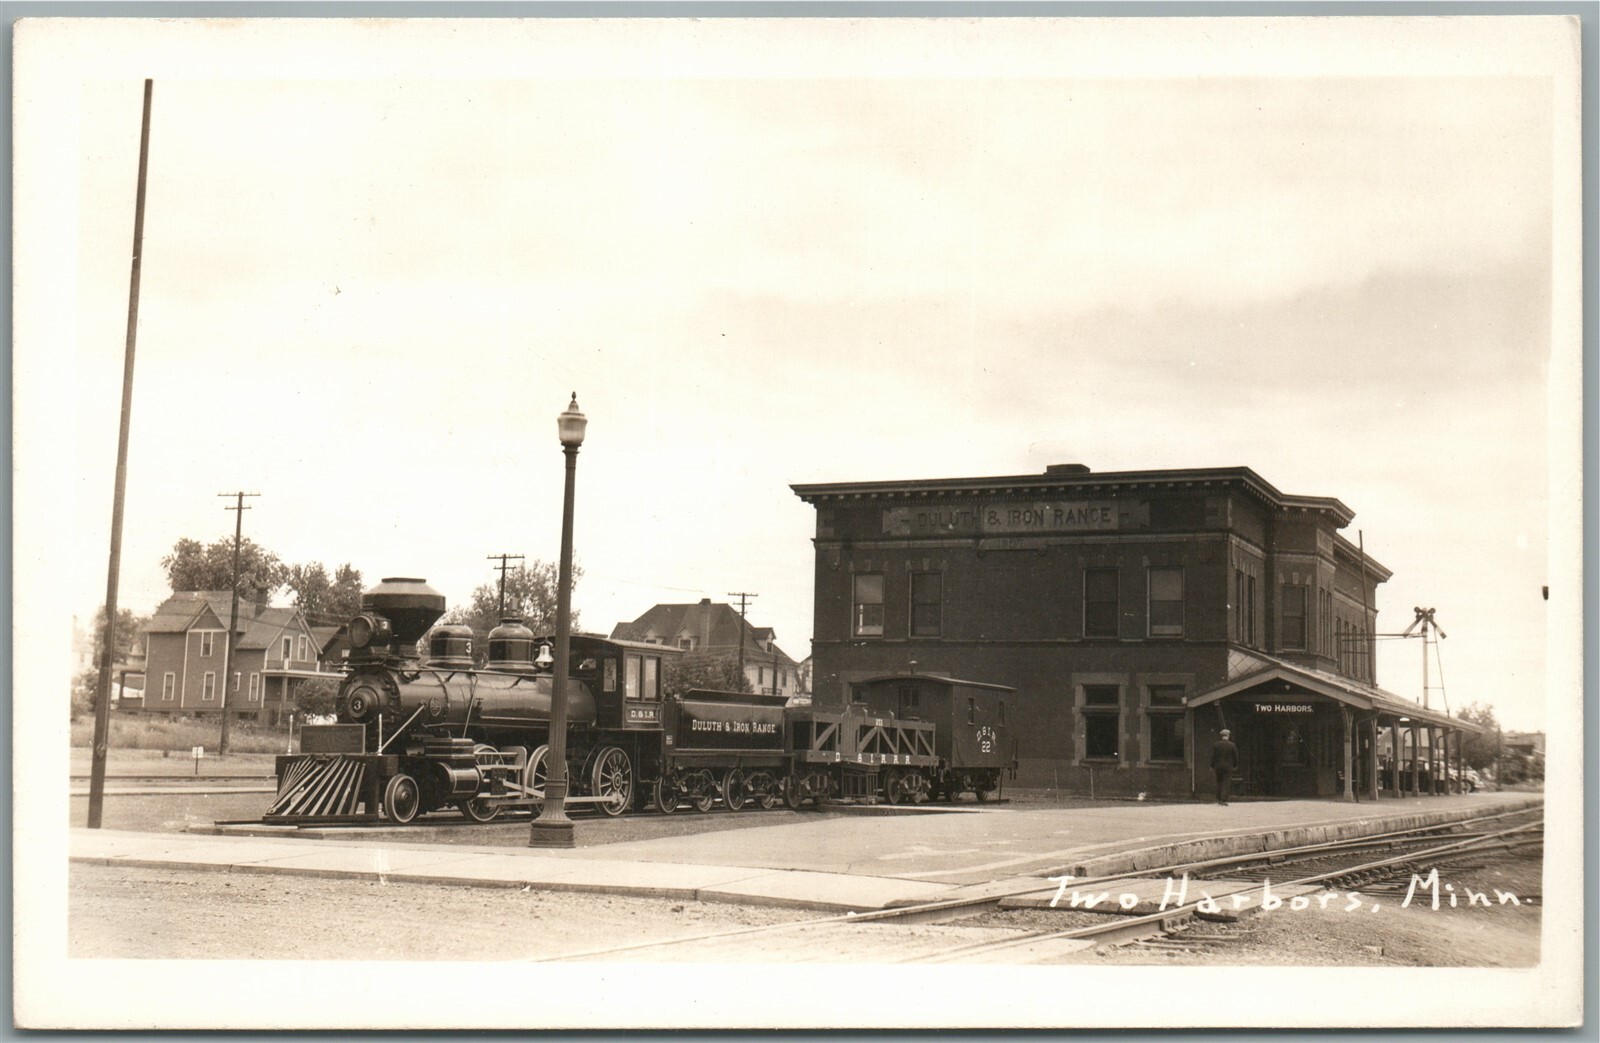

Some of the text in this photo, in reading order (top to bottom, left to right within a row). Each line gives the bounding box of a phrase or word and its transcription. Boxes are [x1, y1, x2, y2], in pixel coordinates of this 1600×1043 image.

[917, 510, 980, 527] DULUTH
[987, 510, 1001, 526] &
[1007, 509, 1044, 525] IRON
[466, 642, 472, 653] 3
[354, 700, 361, 710] 3
[1256, 704, 1272, 712] TWO
[692, 719, 776, 734] DULUTH & IRON RANGE
[981, 740, 991, 753] 22
